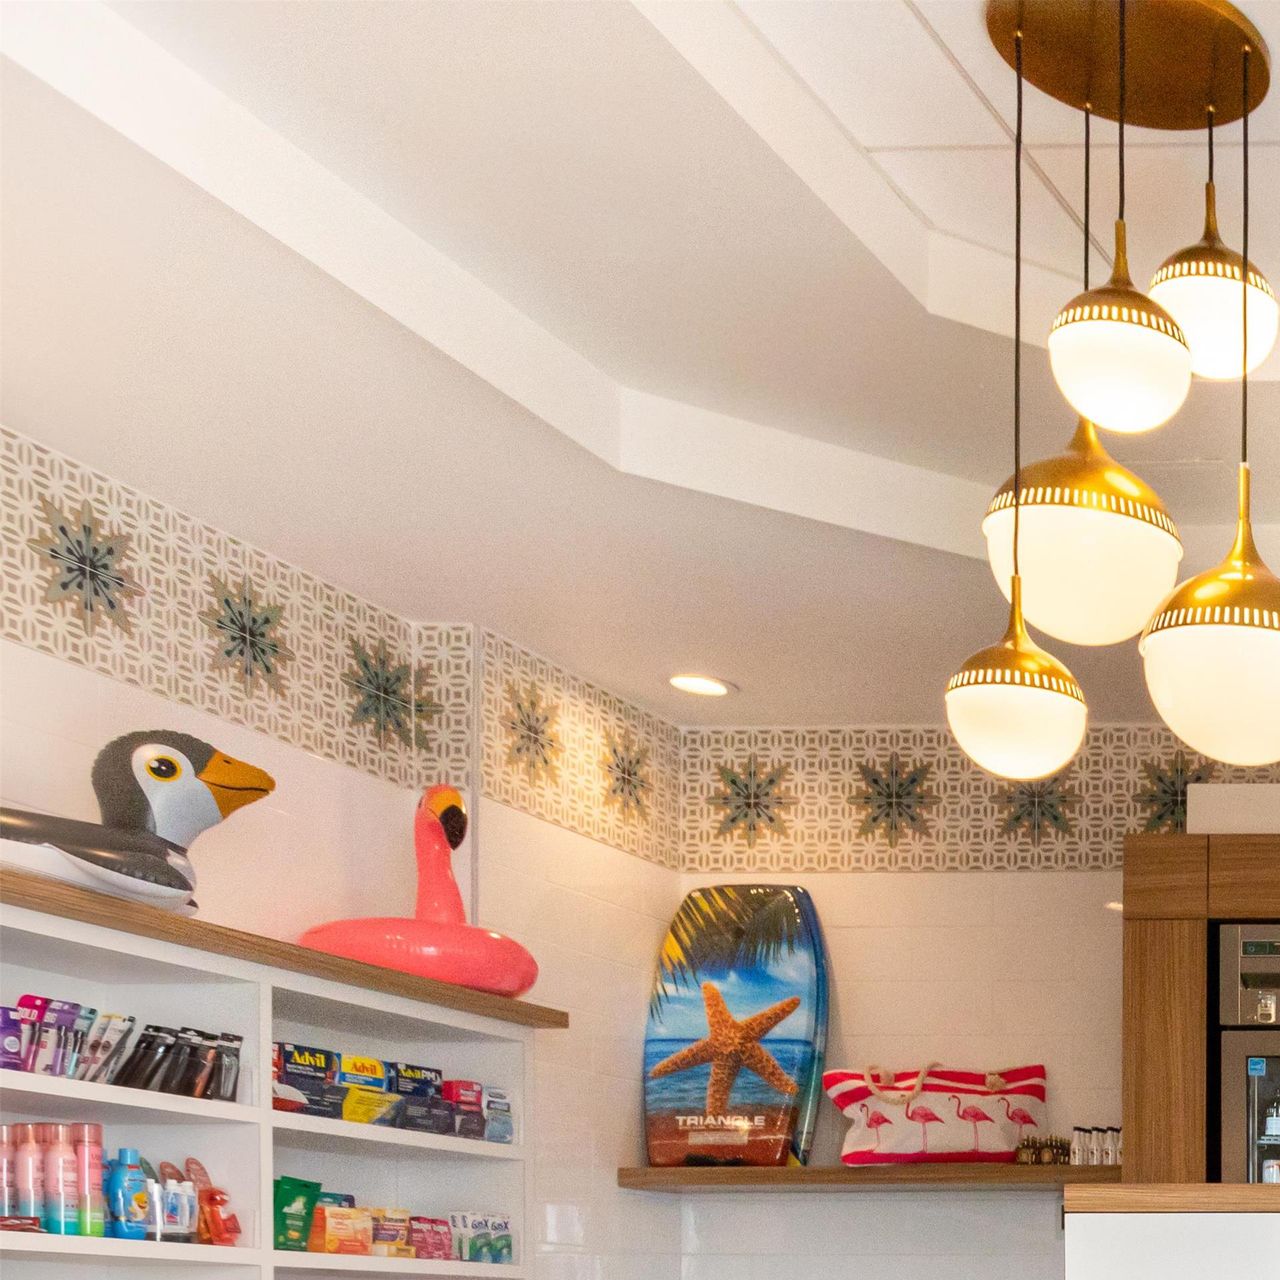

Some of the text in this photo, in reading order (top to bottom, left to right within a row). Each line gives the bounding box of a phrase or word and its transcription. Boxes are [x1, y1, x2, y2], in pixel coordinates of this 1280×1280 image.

[291, 1050, 325, 1068] Advil
[352, 1061, 377, 1075] Advil
[398, 1068, 421, 1079] Advil
[675, 1115, 766, 1126] TRIANGLE
